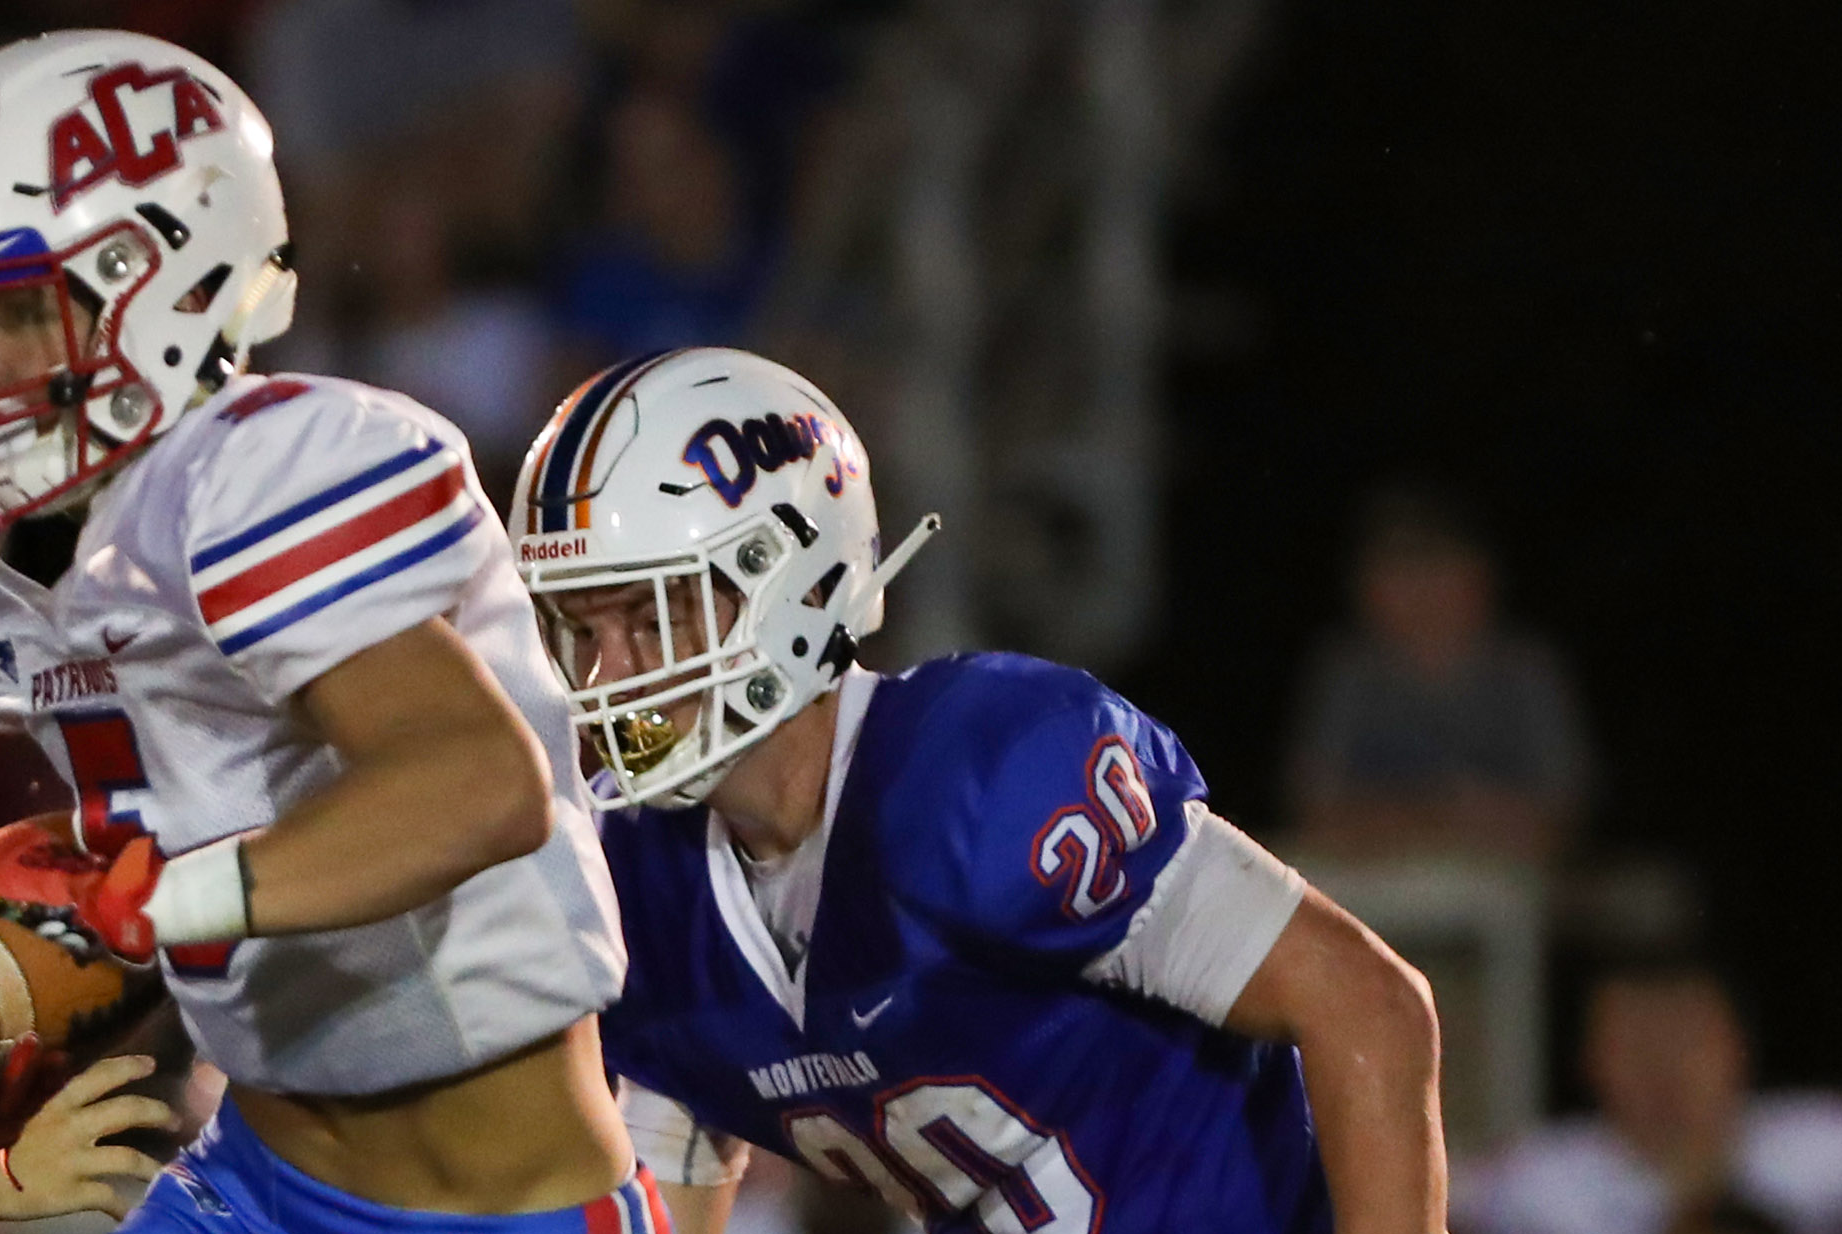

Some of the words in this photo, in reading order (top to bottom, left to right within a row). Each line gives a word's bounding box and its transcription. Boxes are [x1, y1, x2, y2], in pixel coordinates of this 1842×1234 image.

[49, 62, 229, 215] ACA
[682, 412, 858, 509] Daw
[521, 537, 587, 562] Riddell
[1029, 733, 1158, 921] 20
